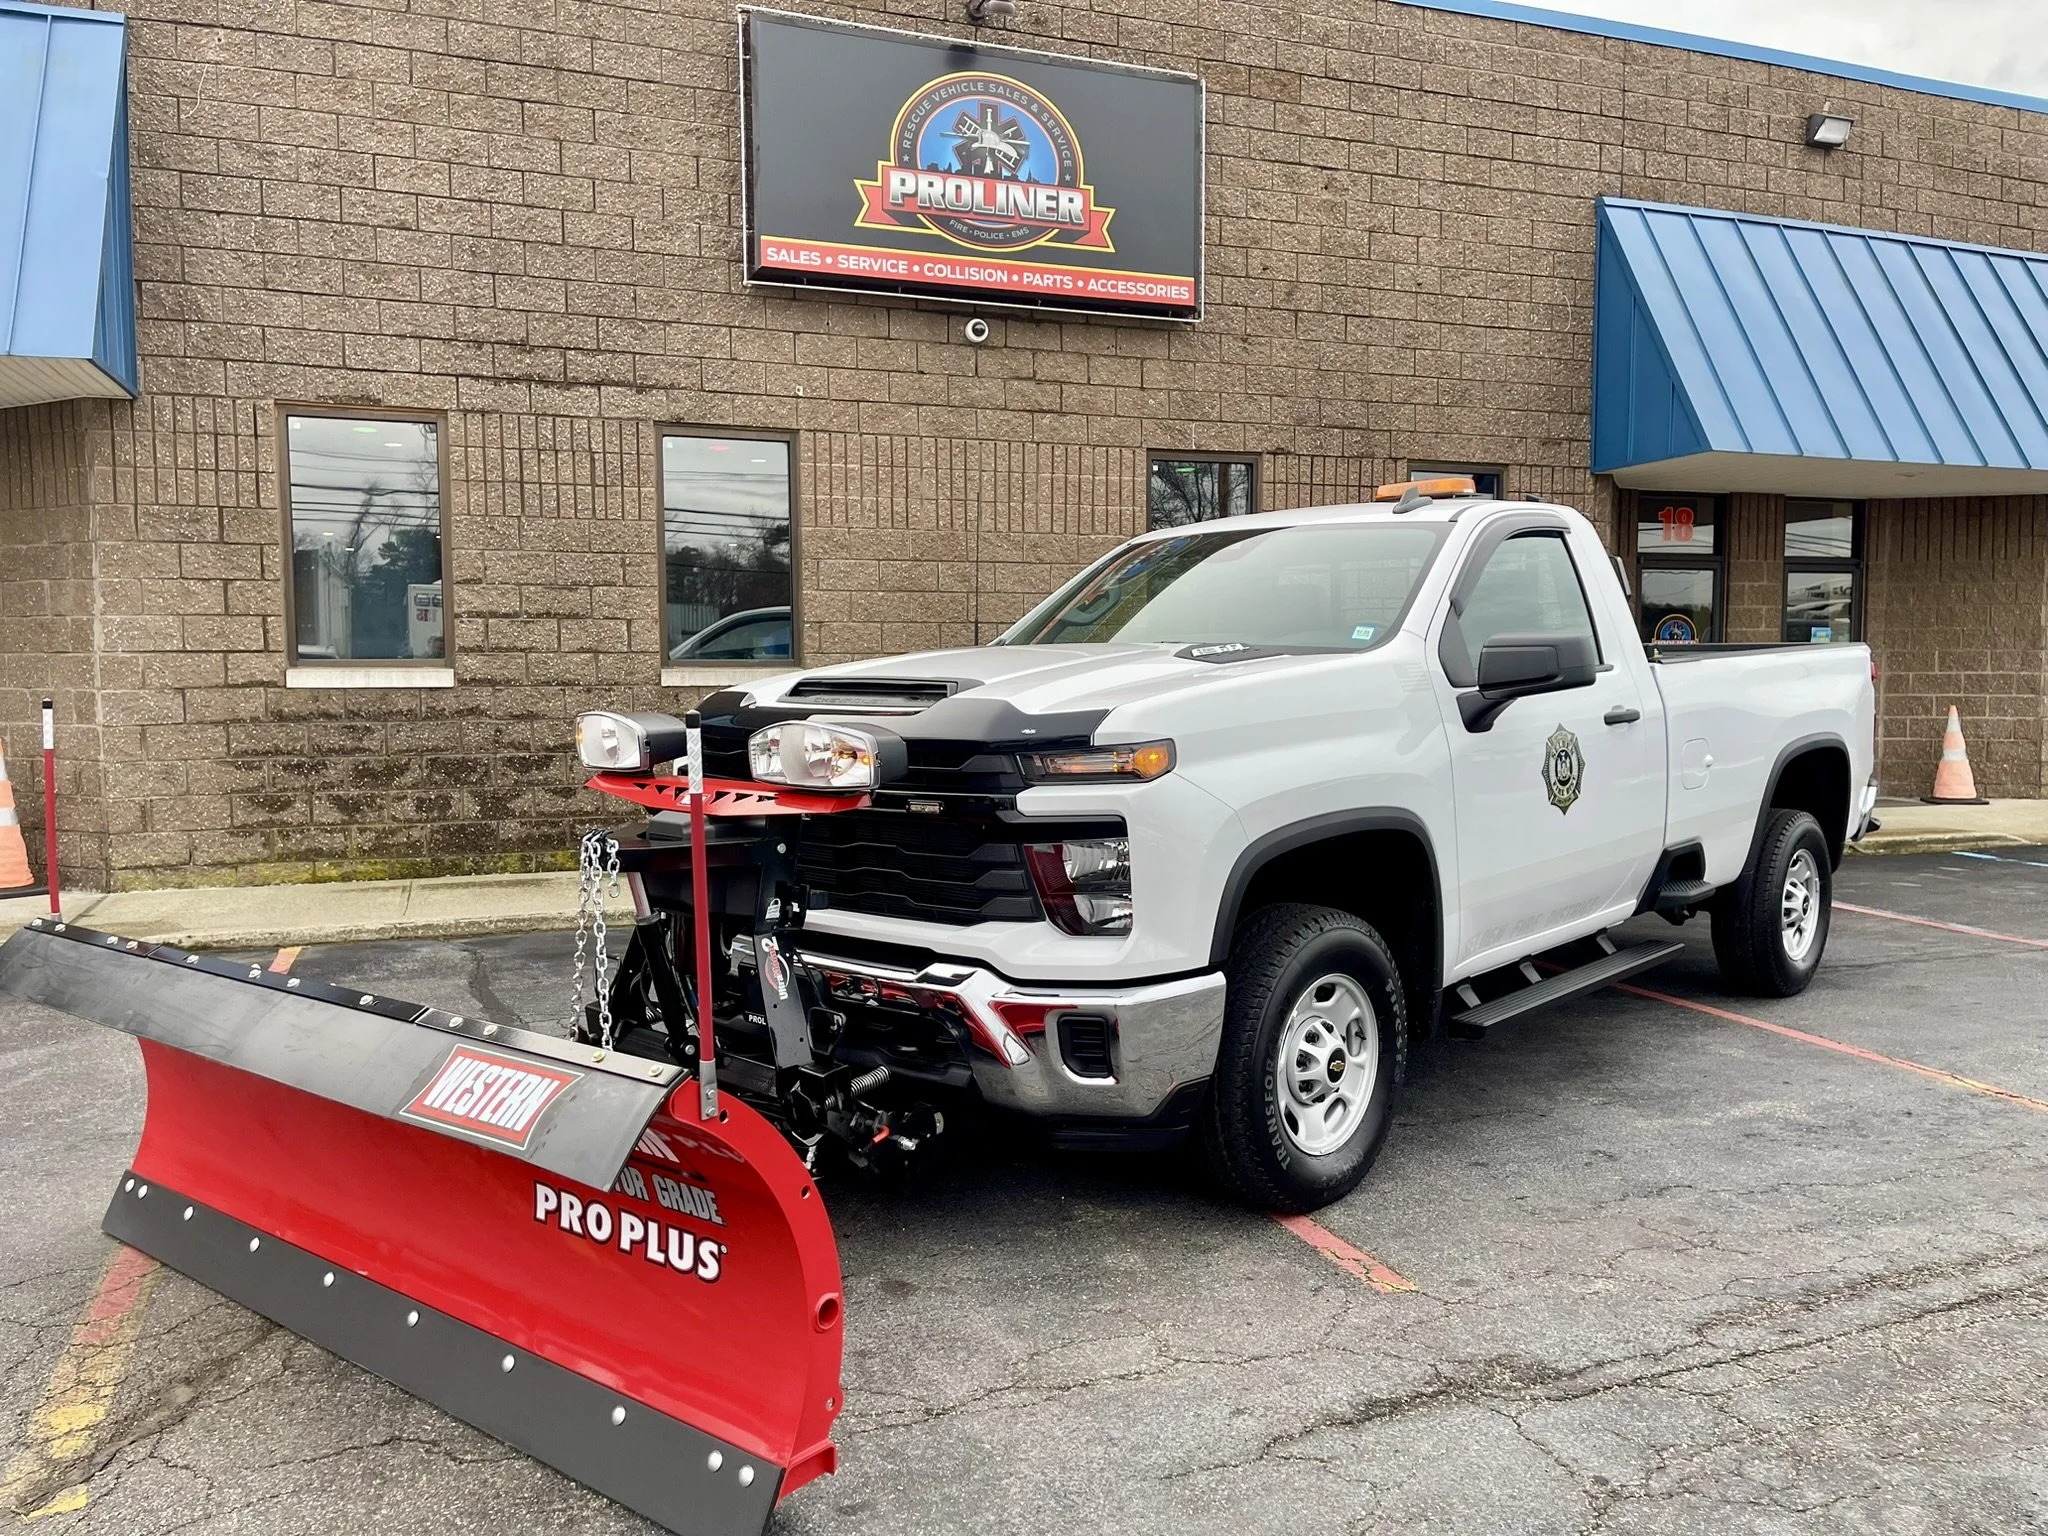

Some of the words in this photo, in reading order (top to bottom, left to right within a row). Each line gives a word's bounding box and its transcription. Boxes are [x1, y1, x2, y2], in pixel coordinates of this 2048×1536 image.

[902, 99, 932, 149] RESCUE
[931, 82, 985, 102] VEHICLE
[989, 83, 1029, 105] SALES
[1030, 102, 1039, 113] &
[1040, 112, 1072, 168] SERVICE
[888, 169, 1085, 225] PROLINER
[949, 219, 969, 234] FIRE
[973, 229, 1005, 240] POLICE
[1011, 226, 1030, 239] EMS
[766, 247, 822, 266] SALES
[837, 254, 909, 274] SERVICE
[923, 262, 1008, 284] COLLISION
[1023, 271, 1074, 289] PARTS
[1087, 278, 1190, 300] ACCESSORIES
[1658, 506, 1694, 543] 18
[748, 1013, 767, 1026] PROL
[422, 1055, 561, 1132] WESTERN
[534, 1182, 614, 1243] PRO
[652, 1173, 724, 1225] GRADE
